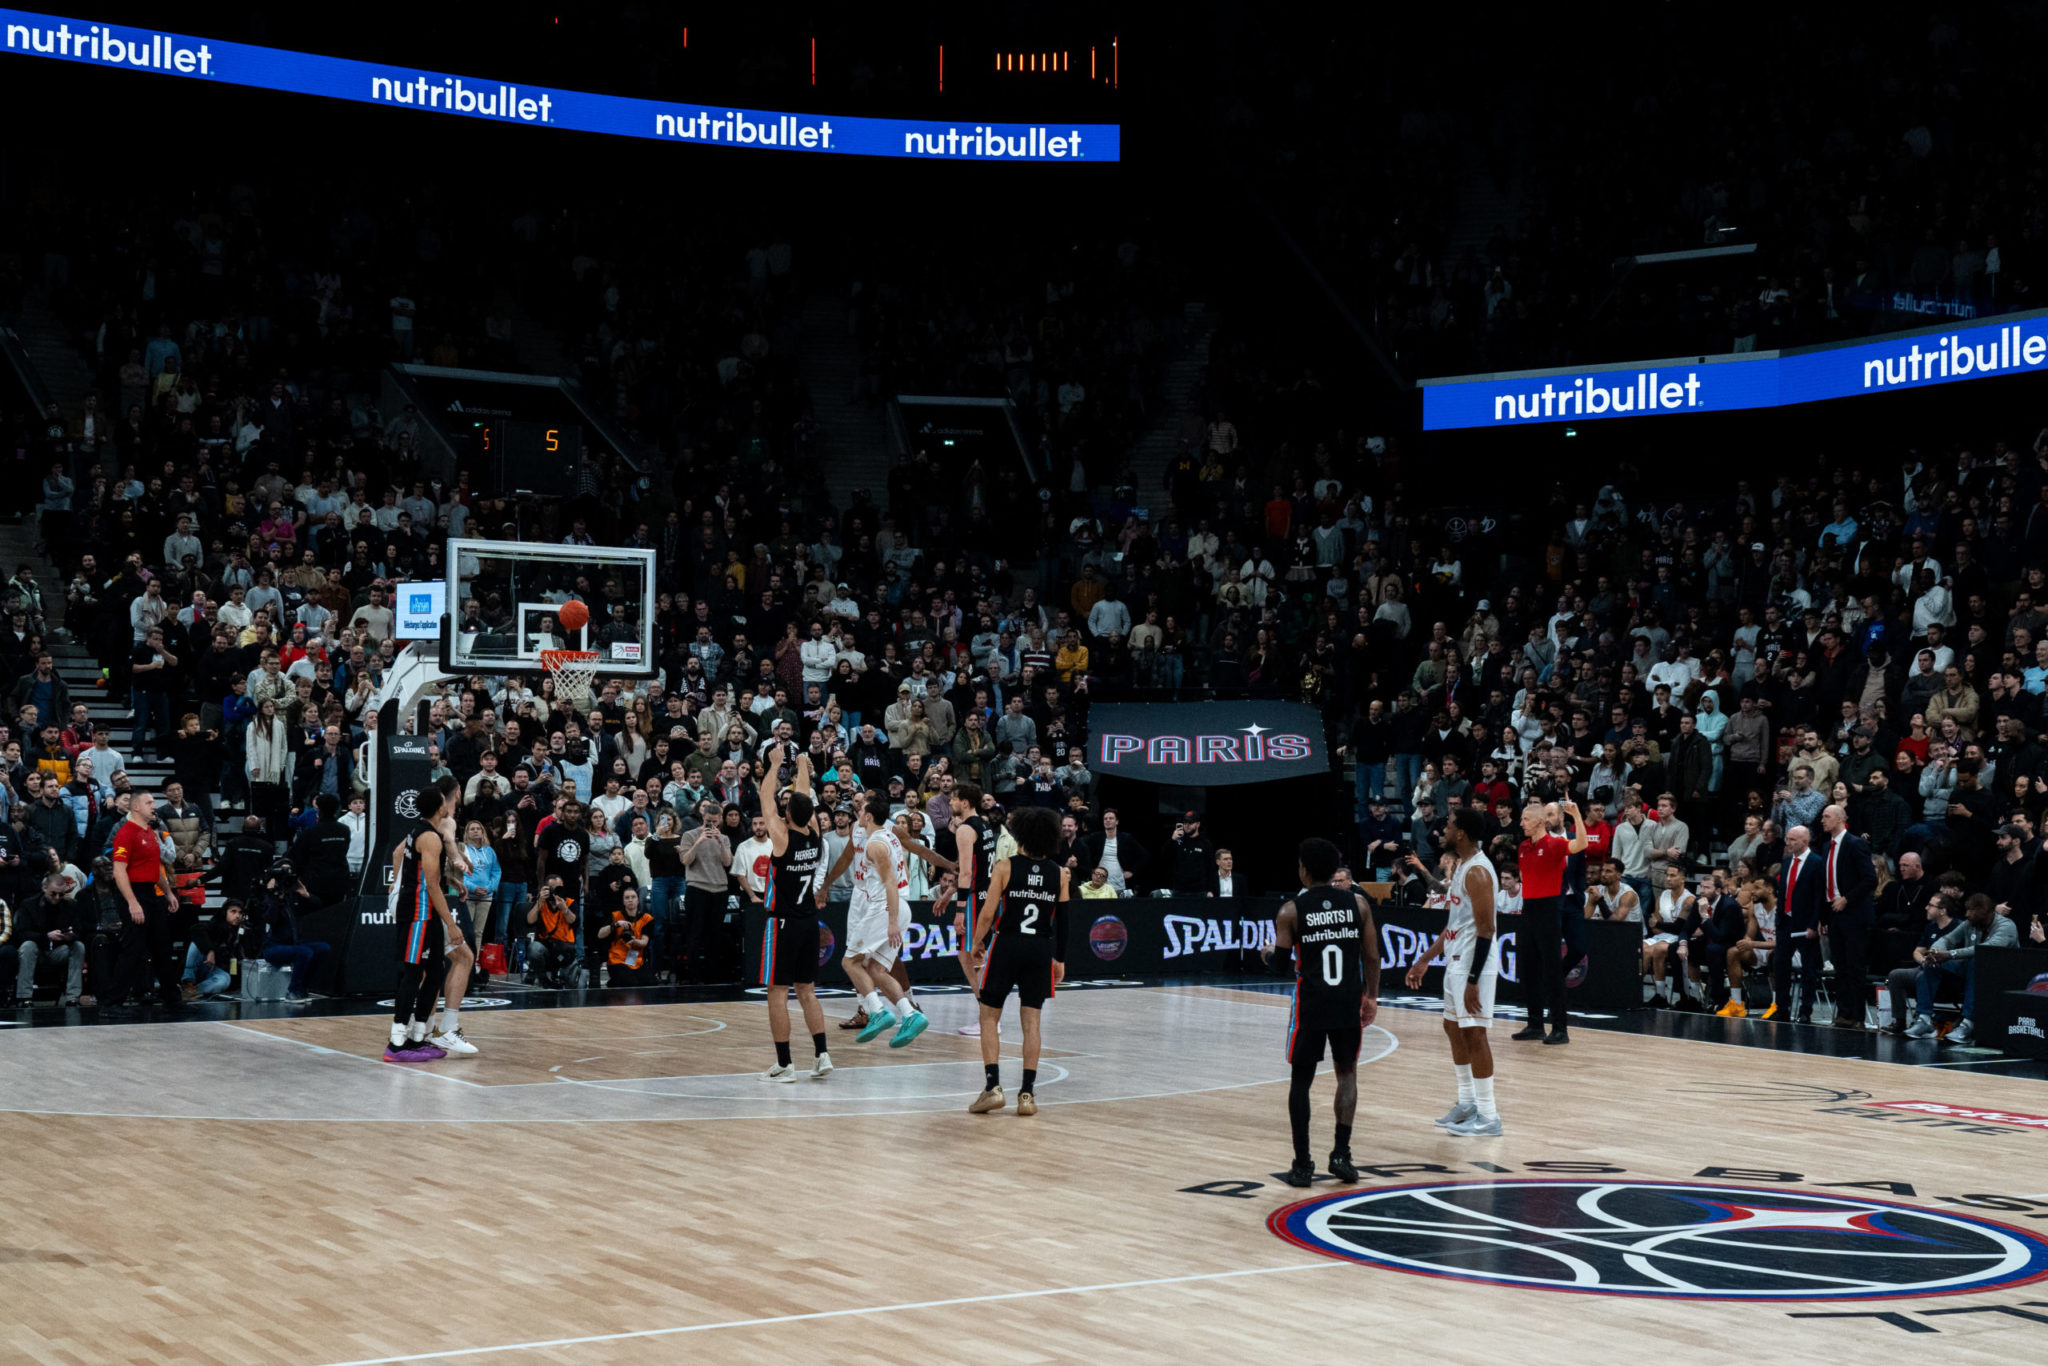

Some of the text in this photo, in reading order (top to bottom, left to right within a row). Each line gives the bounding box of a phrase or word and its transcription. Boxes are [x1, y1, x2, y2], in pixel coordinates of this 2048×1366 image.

[7, 24, 212, 75] nutribullet
[372, 76, 553, 123] nutribullet
[656, 111, 834, 149] nutribullet
[905, 126, 1083, 158] nutribullet
[1495, 372, 1702, 420] nutribullet
[546, 429, 559, 451] 5
[393, 745, 426, 755] SPALDING
[1101, 732, 1312, 764] PARIS
[797, 875, 812, 905] 7
[1009, 888, 1057, 903] nutribullet
[1027, 873, 1044, 888] HIFI
[779, 918, 787, 930] 7
[1019, 903, 1040, 935] 2
[1306, 910, 1346, 928] SHORTS
[1163, 914, 1297, 960] SPALDIN
[1301, 928, 1361, 944] nutribullet
[1322, 944, 1343, 986] 0
[2008, 1025, 2046, 1039] BASKETBALL
[2018, 1015, 2036, 1027] PARIS
